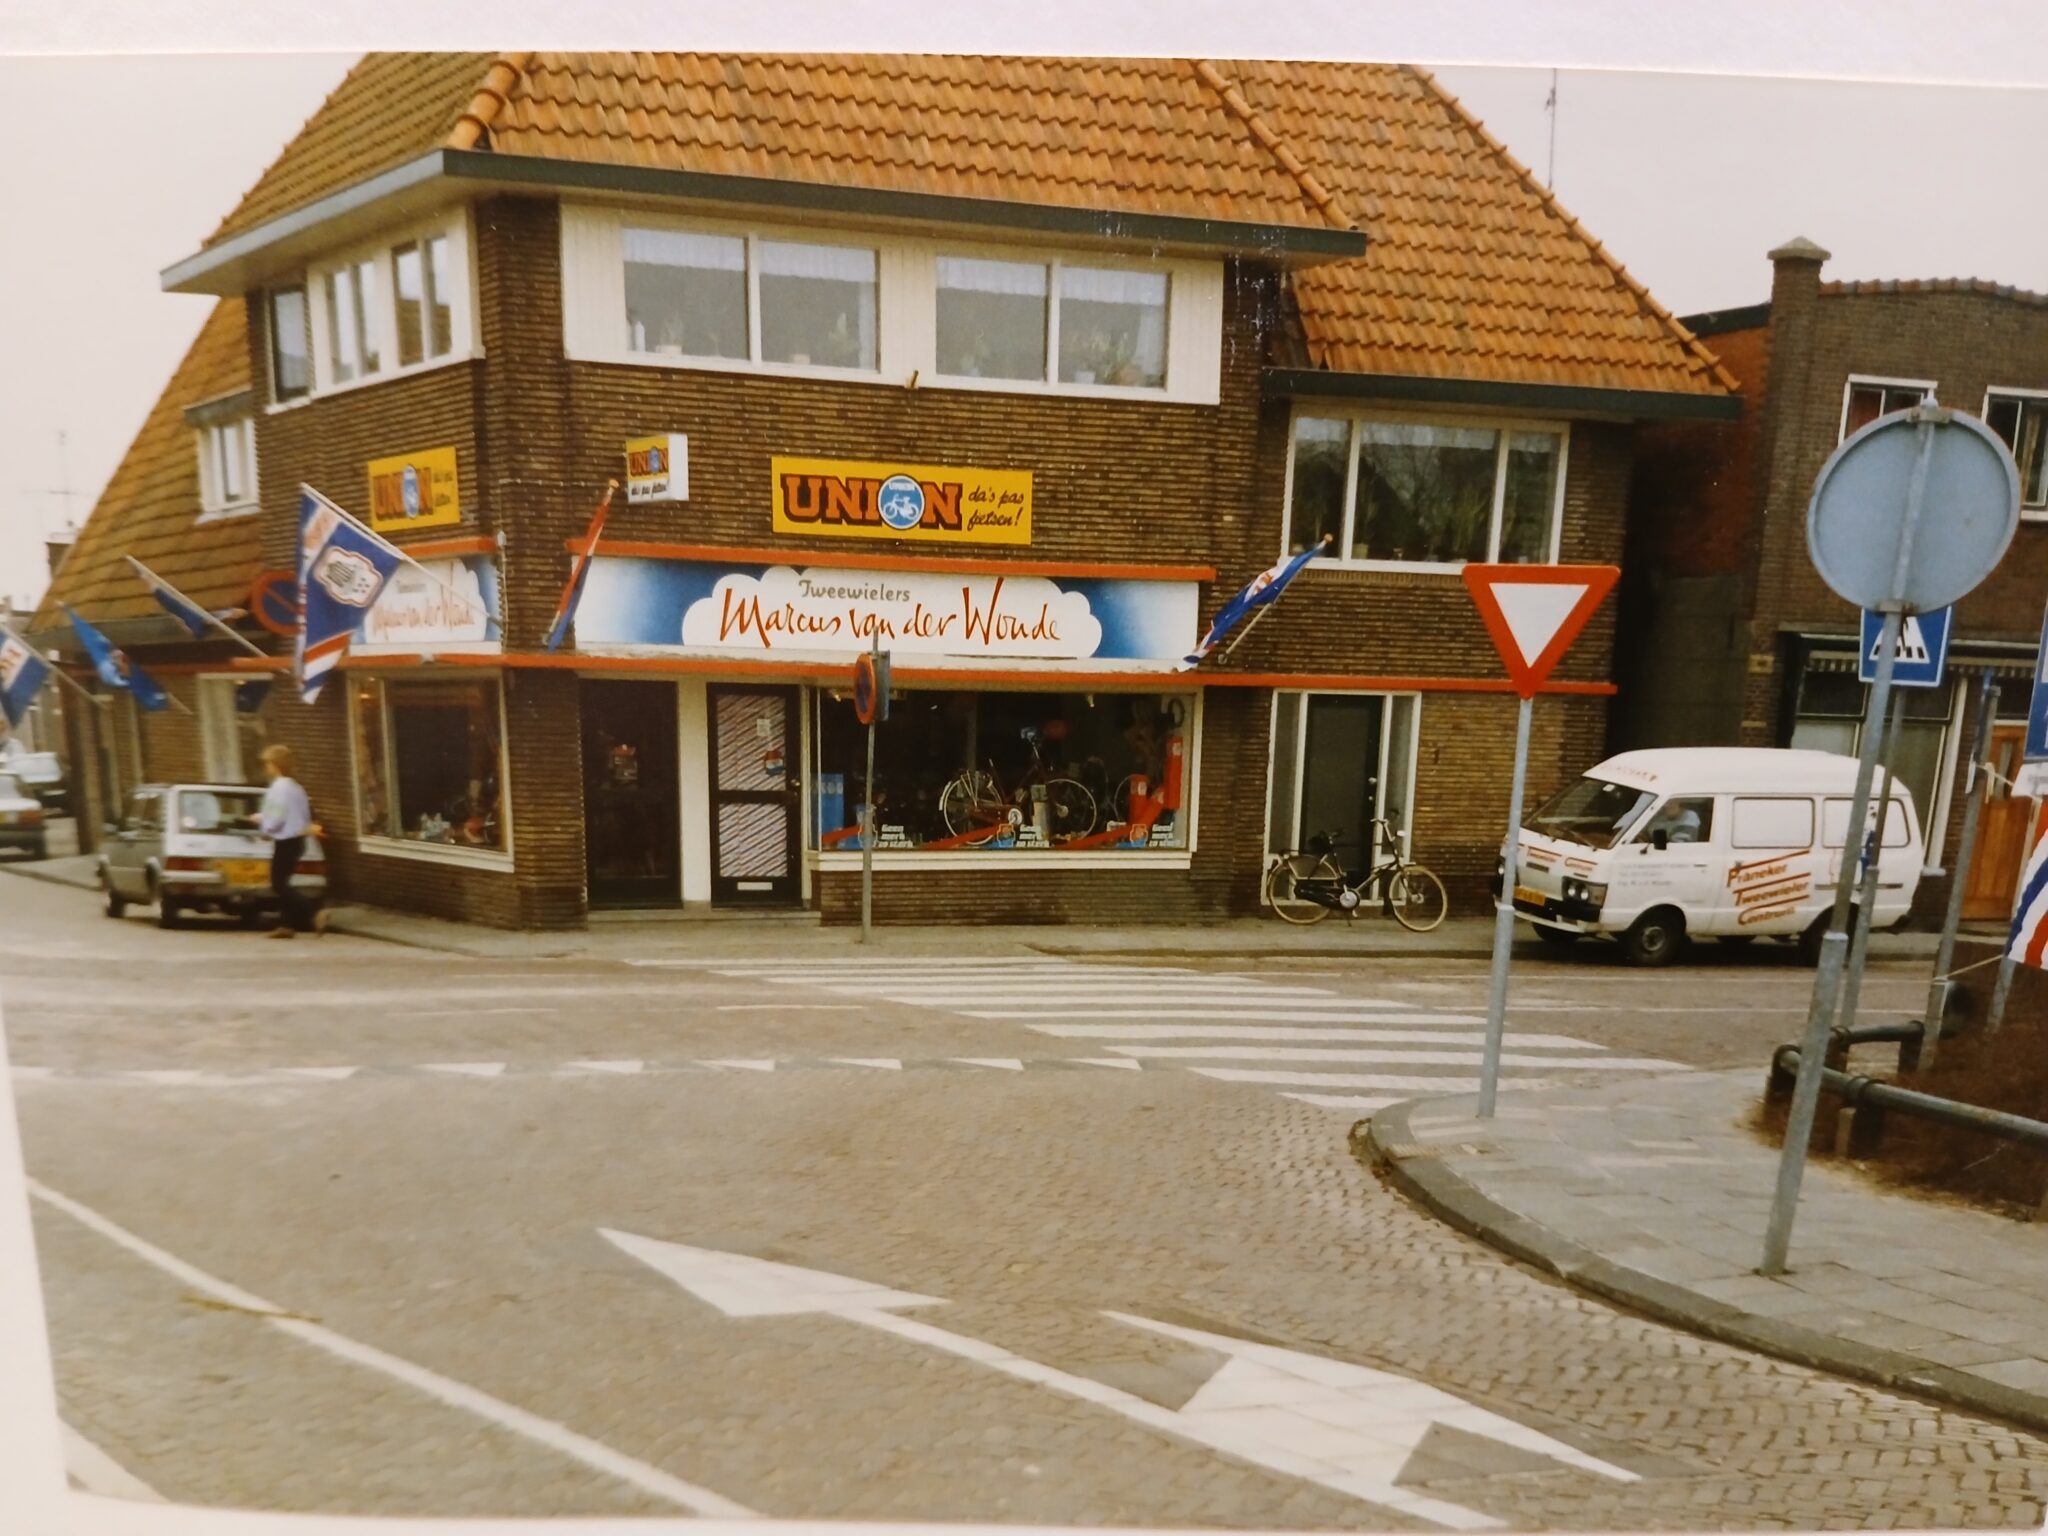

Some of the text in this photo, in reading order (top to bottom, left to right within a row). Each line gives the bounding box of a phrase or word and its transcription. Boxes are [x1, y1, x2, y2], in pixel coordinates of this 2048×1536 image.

[780, 473, 963, 531] UNION
[968, 485, 1024, 508] da's pas
[967, 506, 1023, 531] fietsen!
[799, 579, 911, 602] Tweewielers
[719, 587, 841, 649] Marcus
[903, 602, 957, 638] der
